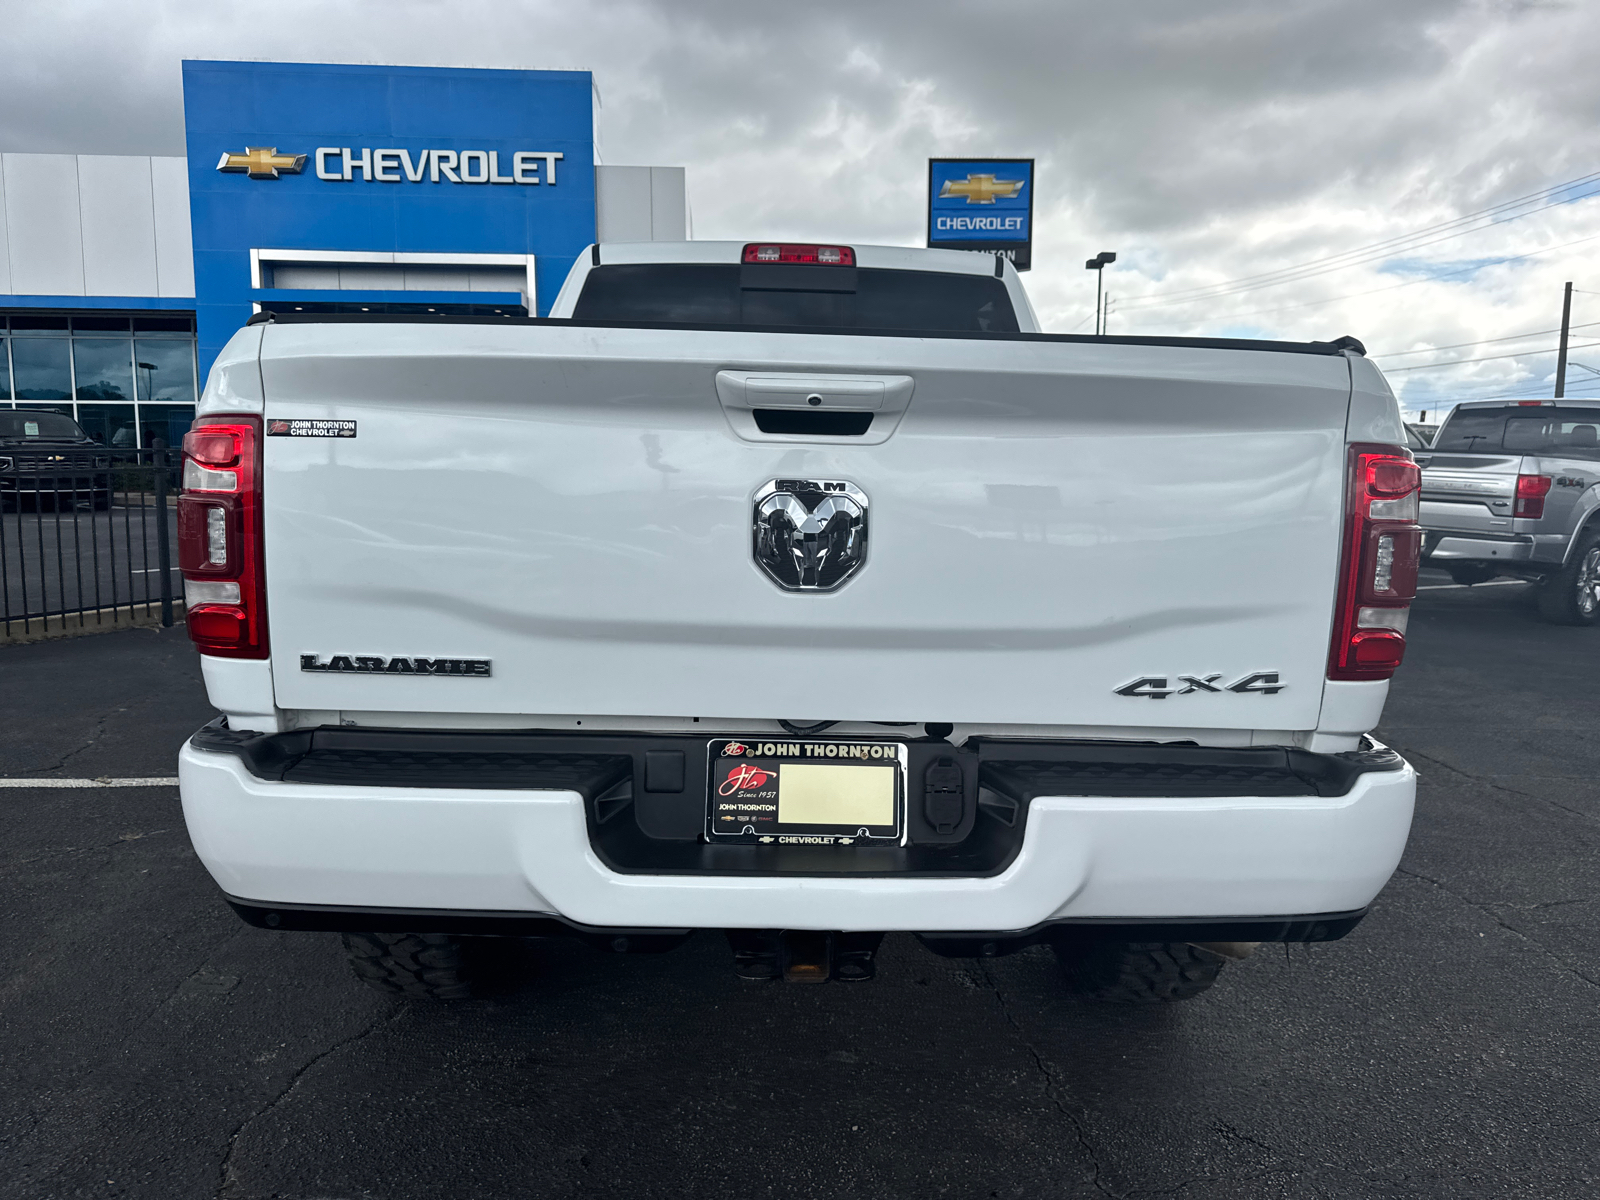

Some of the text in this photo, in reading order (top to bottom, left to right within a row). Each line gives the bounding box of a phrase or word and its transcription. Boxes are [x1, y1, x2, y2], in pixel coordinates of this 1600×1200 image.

[315, 147, 564, 185] CHEVROLET
[937, 217, 1023, 230] CHEVROLET
[290, 421, 355, 429] JOHN THORNTON
[775, 481, 846, 492] RAM
[300, 653, 492, 677] LARAMIE
[755, 743, 895, 759] JOHN THORNTON
[737, 790, 777, 799] Since 1957
[718, 803, 737, 811] JOHN
[778, 836, 835, 845] CHEVROLET
